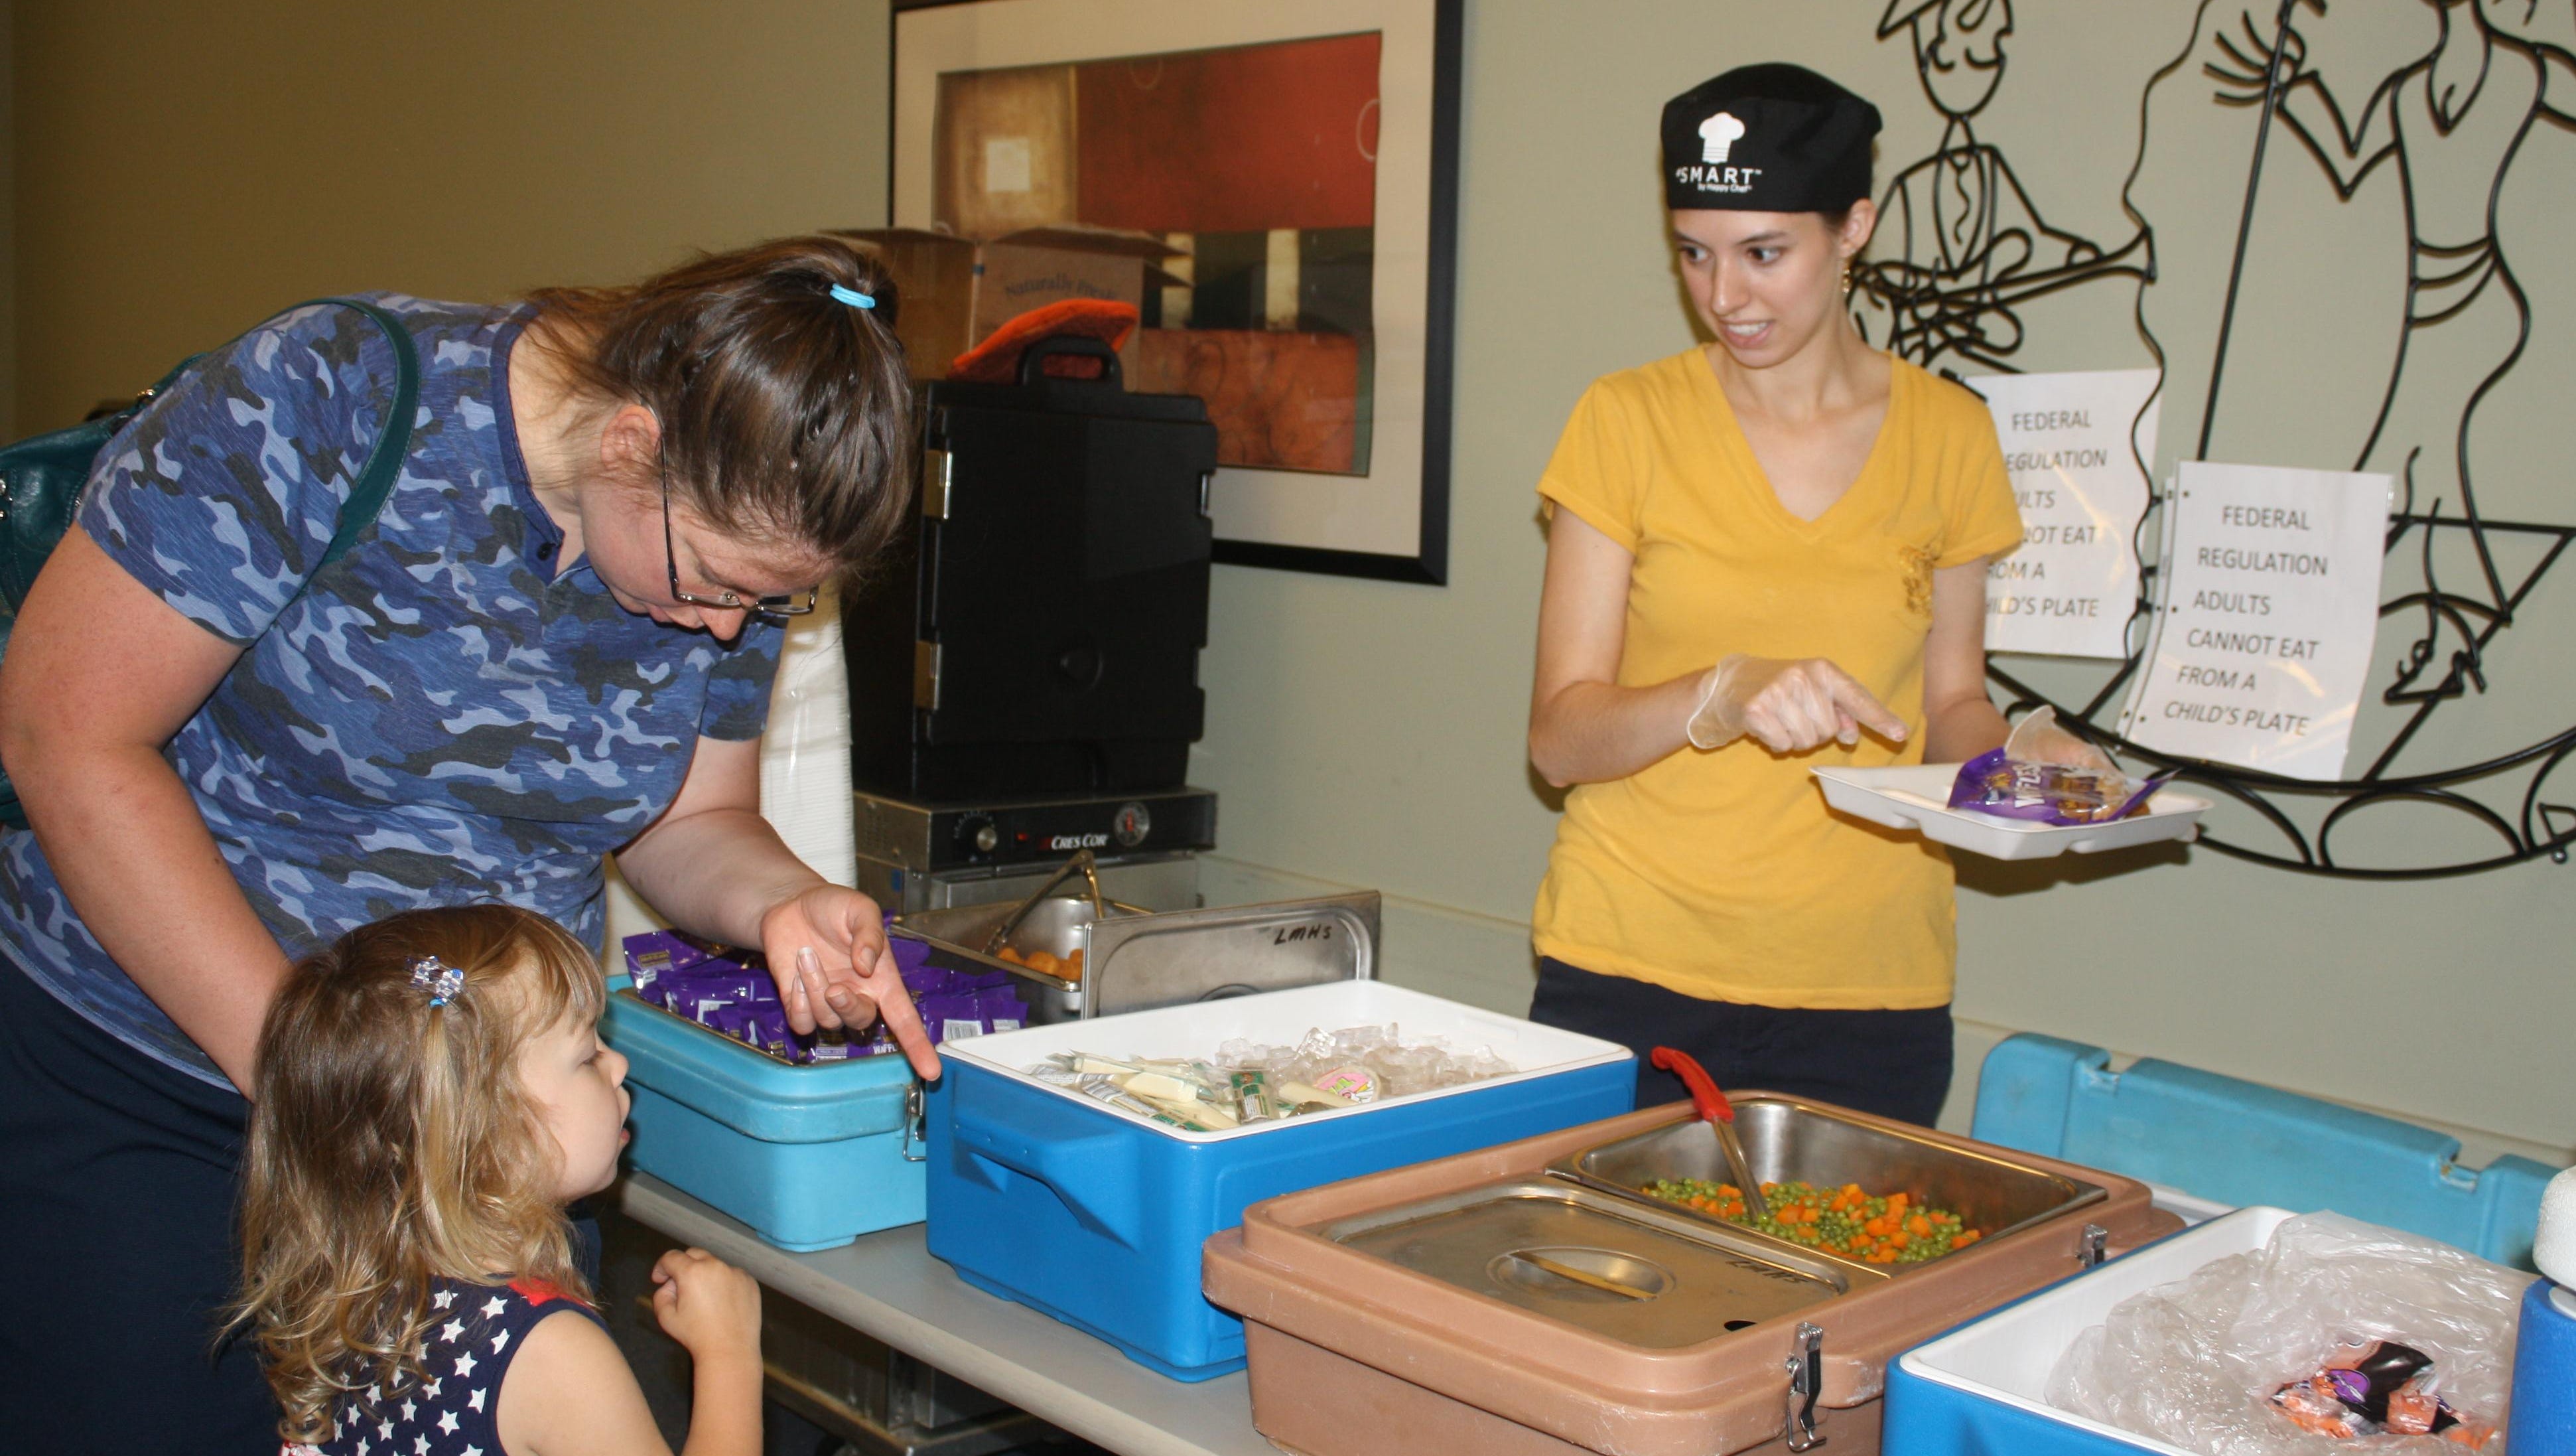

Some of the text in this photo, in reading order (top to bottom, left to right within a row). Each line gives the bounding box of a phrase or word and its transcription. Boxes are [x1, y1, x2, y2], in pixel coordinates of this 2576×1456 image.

[2012, 409, 2092, 431] FEDERAL
[2005, 449, 2108, 472] EGULATION
[2222, 505, 2311, 530] FEDERAL
[2063, 526, 2096, 545] EAT
[2031, 562, 2045, 579] A
[2198, 546, 2328, 576] REGULATION
[2042, 599, 2100, 617] PLATE
[2193, 590, 2271, 616] ADULTS
[2187, 628, 2321, 660] CANNOT EAT
[2177, 665, 2256, 691] FROM A
[2163, 701, 2311, 737] CHILD'S PLATE
[1274, 924, 1332, 946] LMHS
